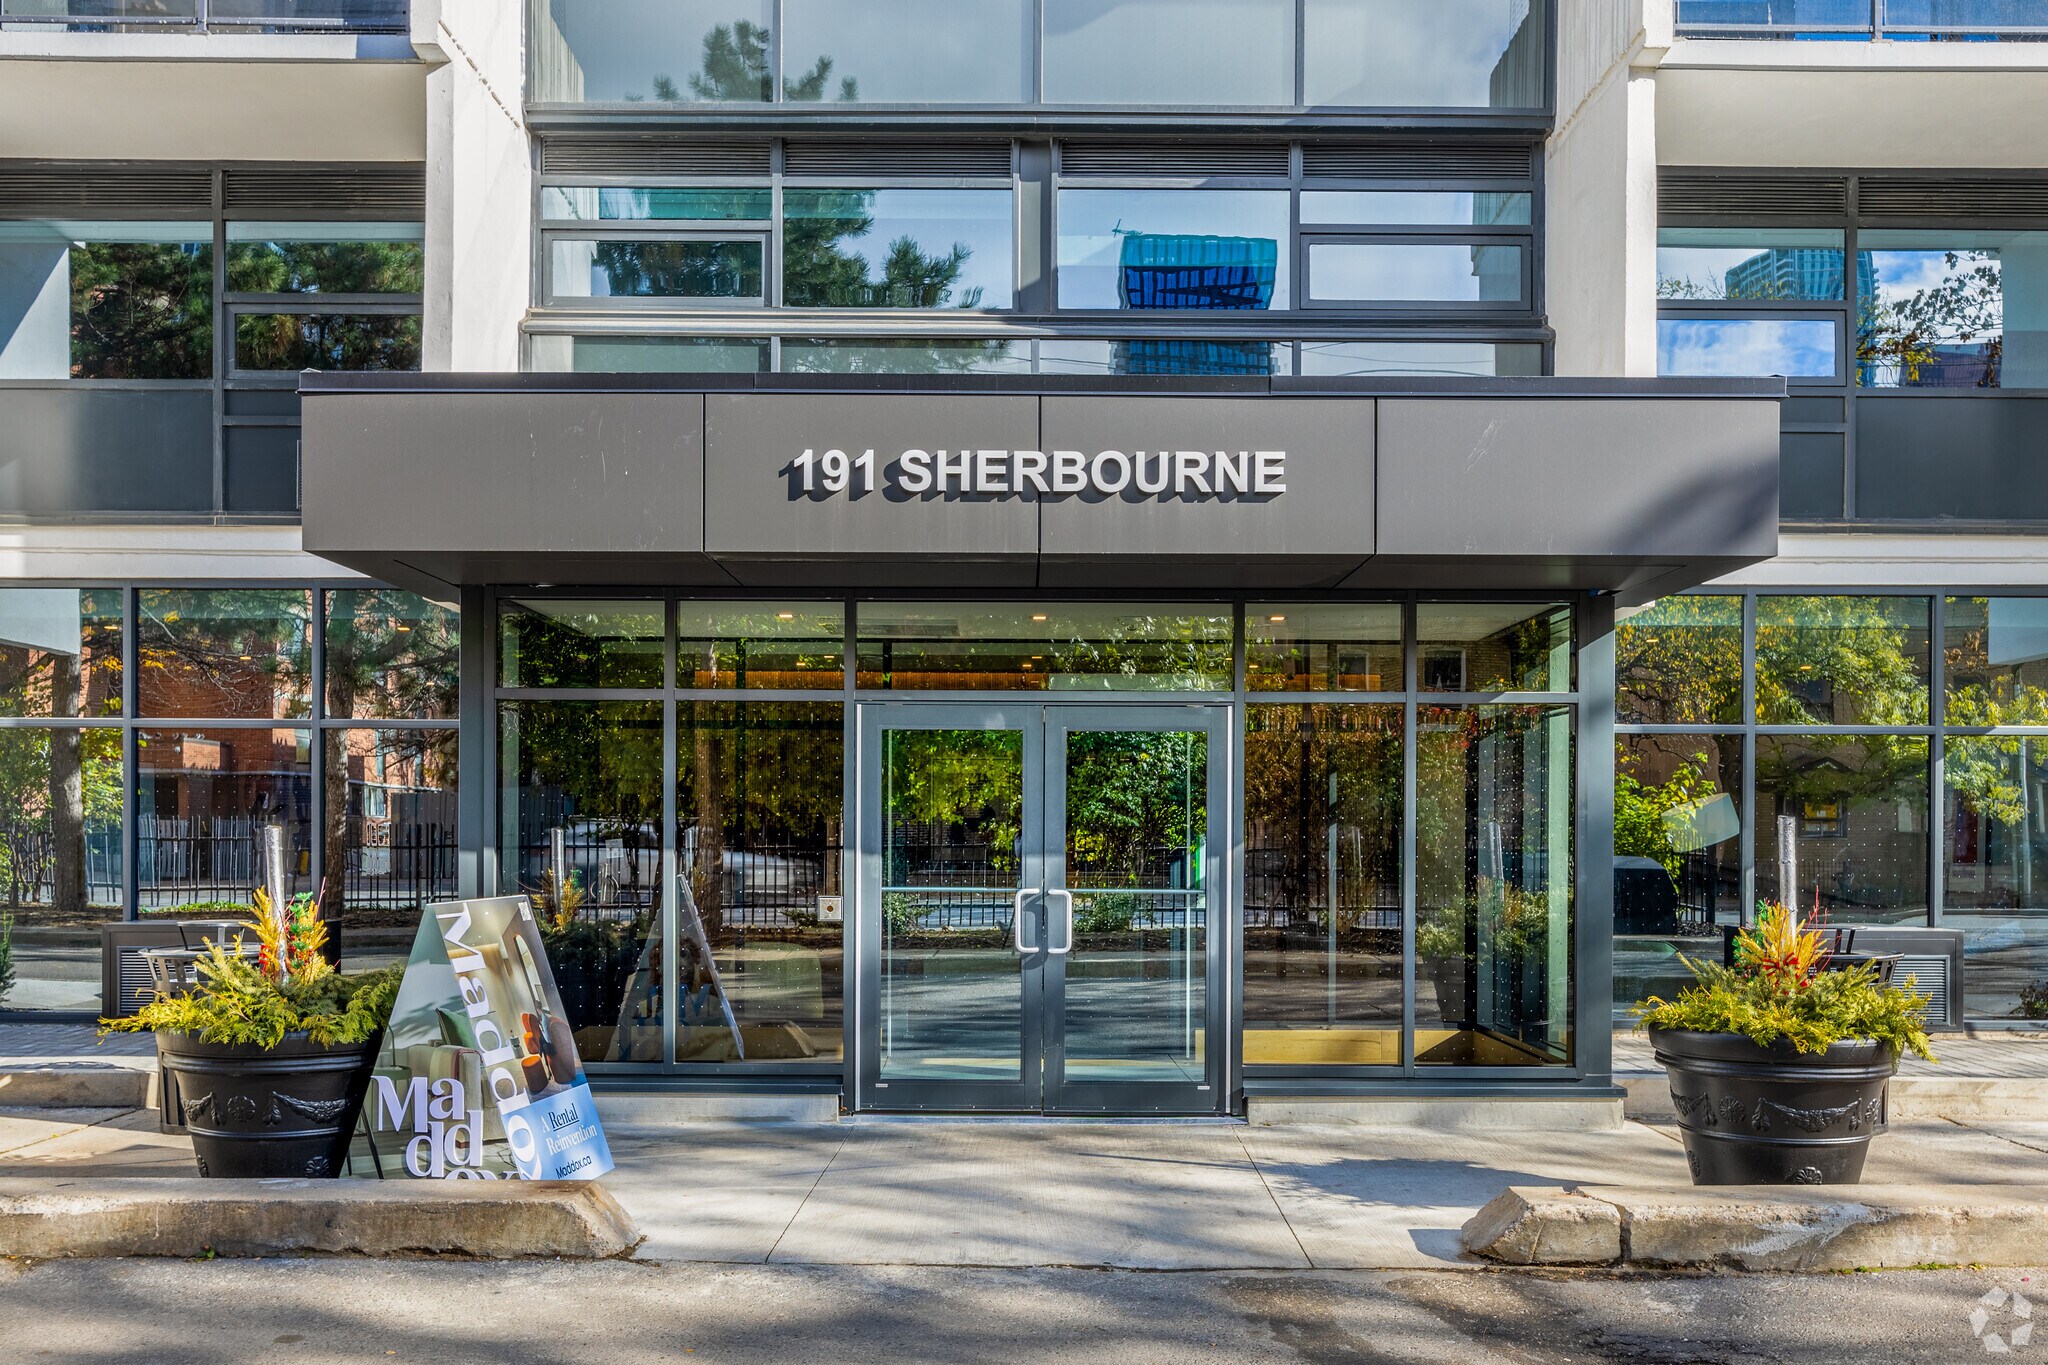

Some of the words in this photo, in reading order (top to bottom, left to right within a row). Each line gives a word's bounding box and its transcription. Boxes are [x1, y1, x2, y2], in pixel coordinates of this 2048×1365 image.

[793, 449, 875, 492] 191
[898, 449, 1287, 493] SHERBOURNE
[370, 1075, 465, 1133] Ma
[541, 1115, 551, 1134] A
[548, 1102, 580, 1131] Rental
[405, 1109, 484, 1178] dd
[545, 1124, 598, 1156] Reinvention
[555, 1155, 592, 1180] Maddox.ca
